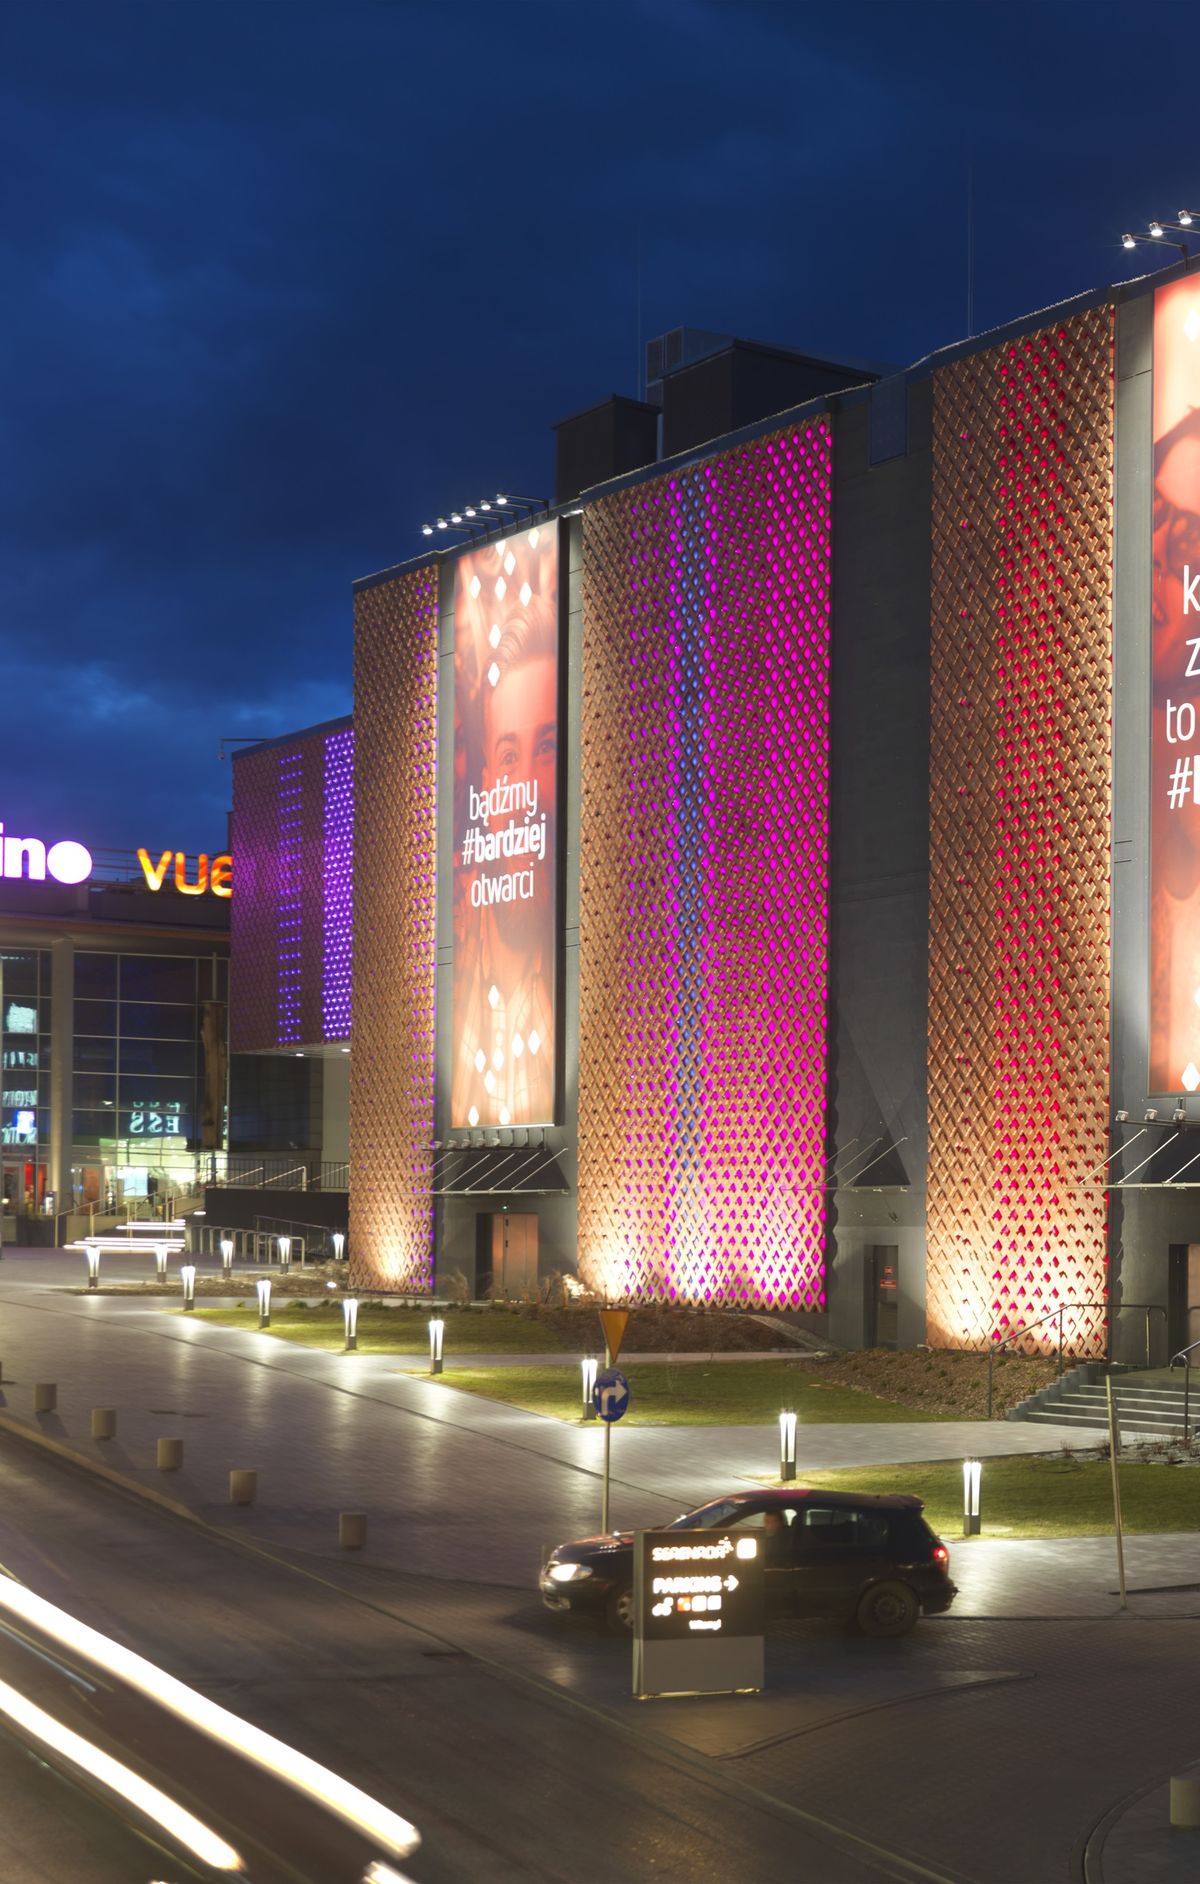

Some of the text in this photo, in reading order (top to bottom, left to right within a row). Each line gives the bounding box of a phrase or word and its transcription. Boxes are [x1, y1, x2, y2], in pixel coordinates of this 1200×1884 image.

[1166, 698, 1196, 743] to
[469, 774, 538, 827] bądźmy
[462, 812, 546, 866] #bardziej
[471, 862, 534, 907] otwarci
